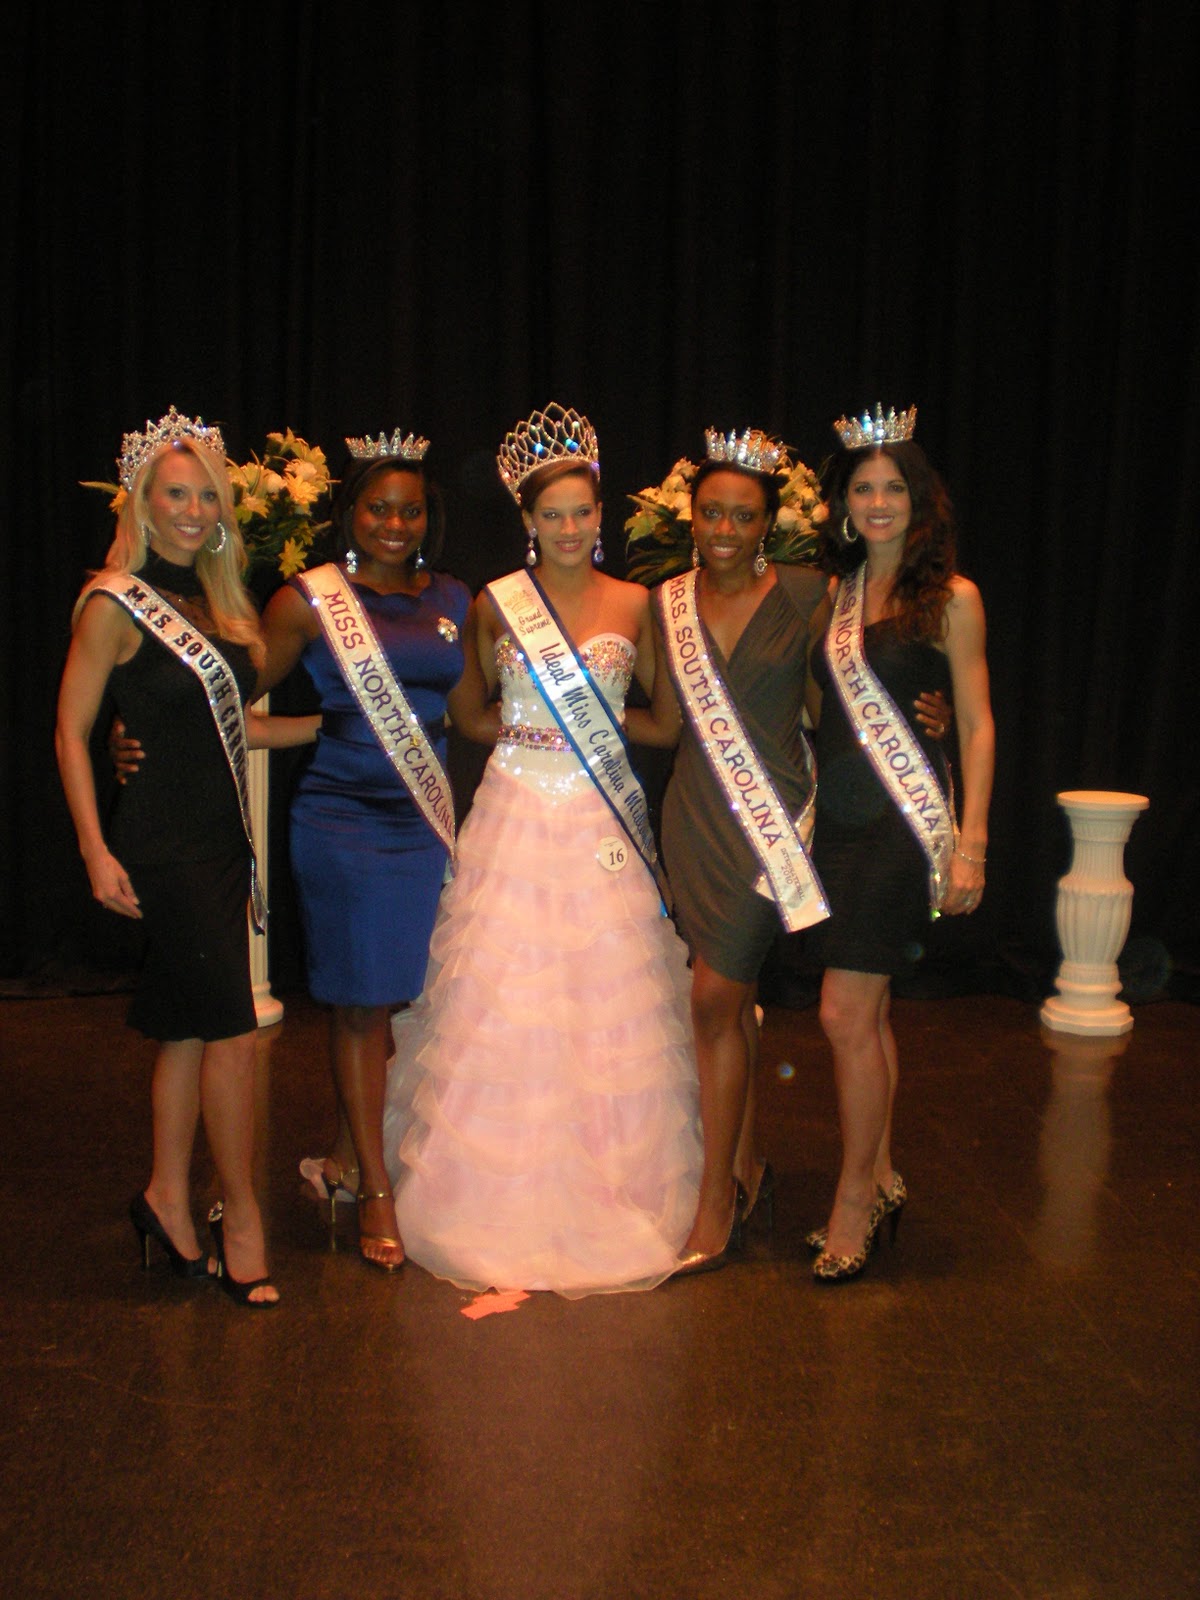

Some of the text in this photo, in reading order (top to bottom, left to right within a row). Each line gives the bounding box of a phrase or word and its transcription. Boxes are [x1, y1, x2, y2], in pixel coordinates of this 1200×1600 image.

[518, 607, 542, 625] Grand
[518, 618, 551, 636] Supreme
[173, 630, 233, 704] SOUTH
[322, 589, 366, 650] MISS
[352, 653, 412, 746] NORTH
[539, 642, 625, 793] Ideal Miss Carolina
[675, 625, 719, 713] SOUTH
[709, 717, 785, 849] CAROLINA
[836, 613, 870, 699] NORTH
[862, 701, 941, 834] CAROLINA
[609, 848, 624, 866] 16
[781, 864, 793, 885] 2010
